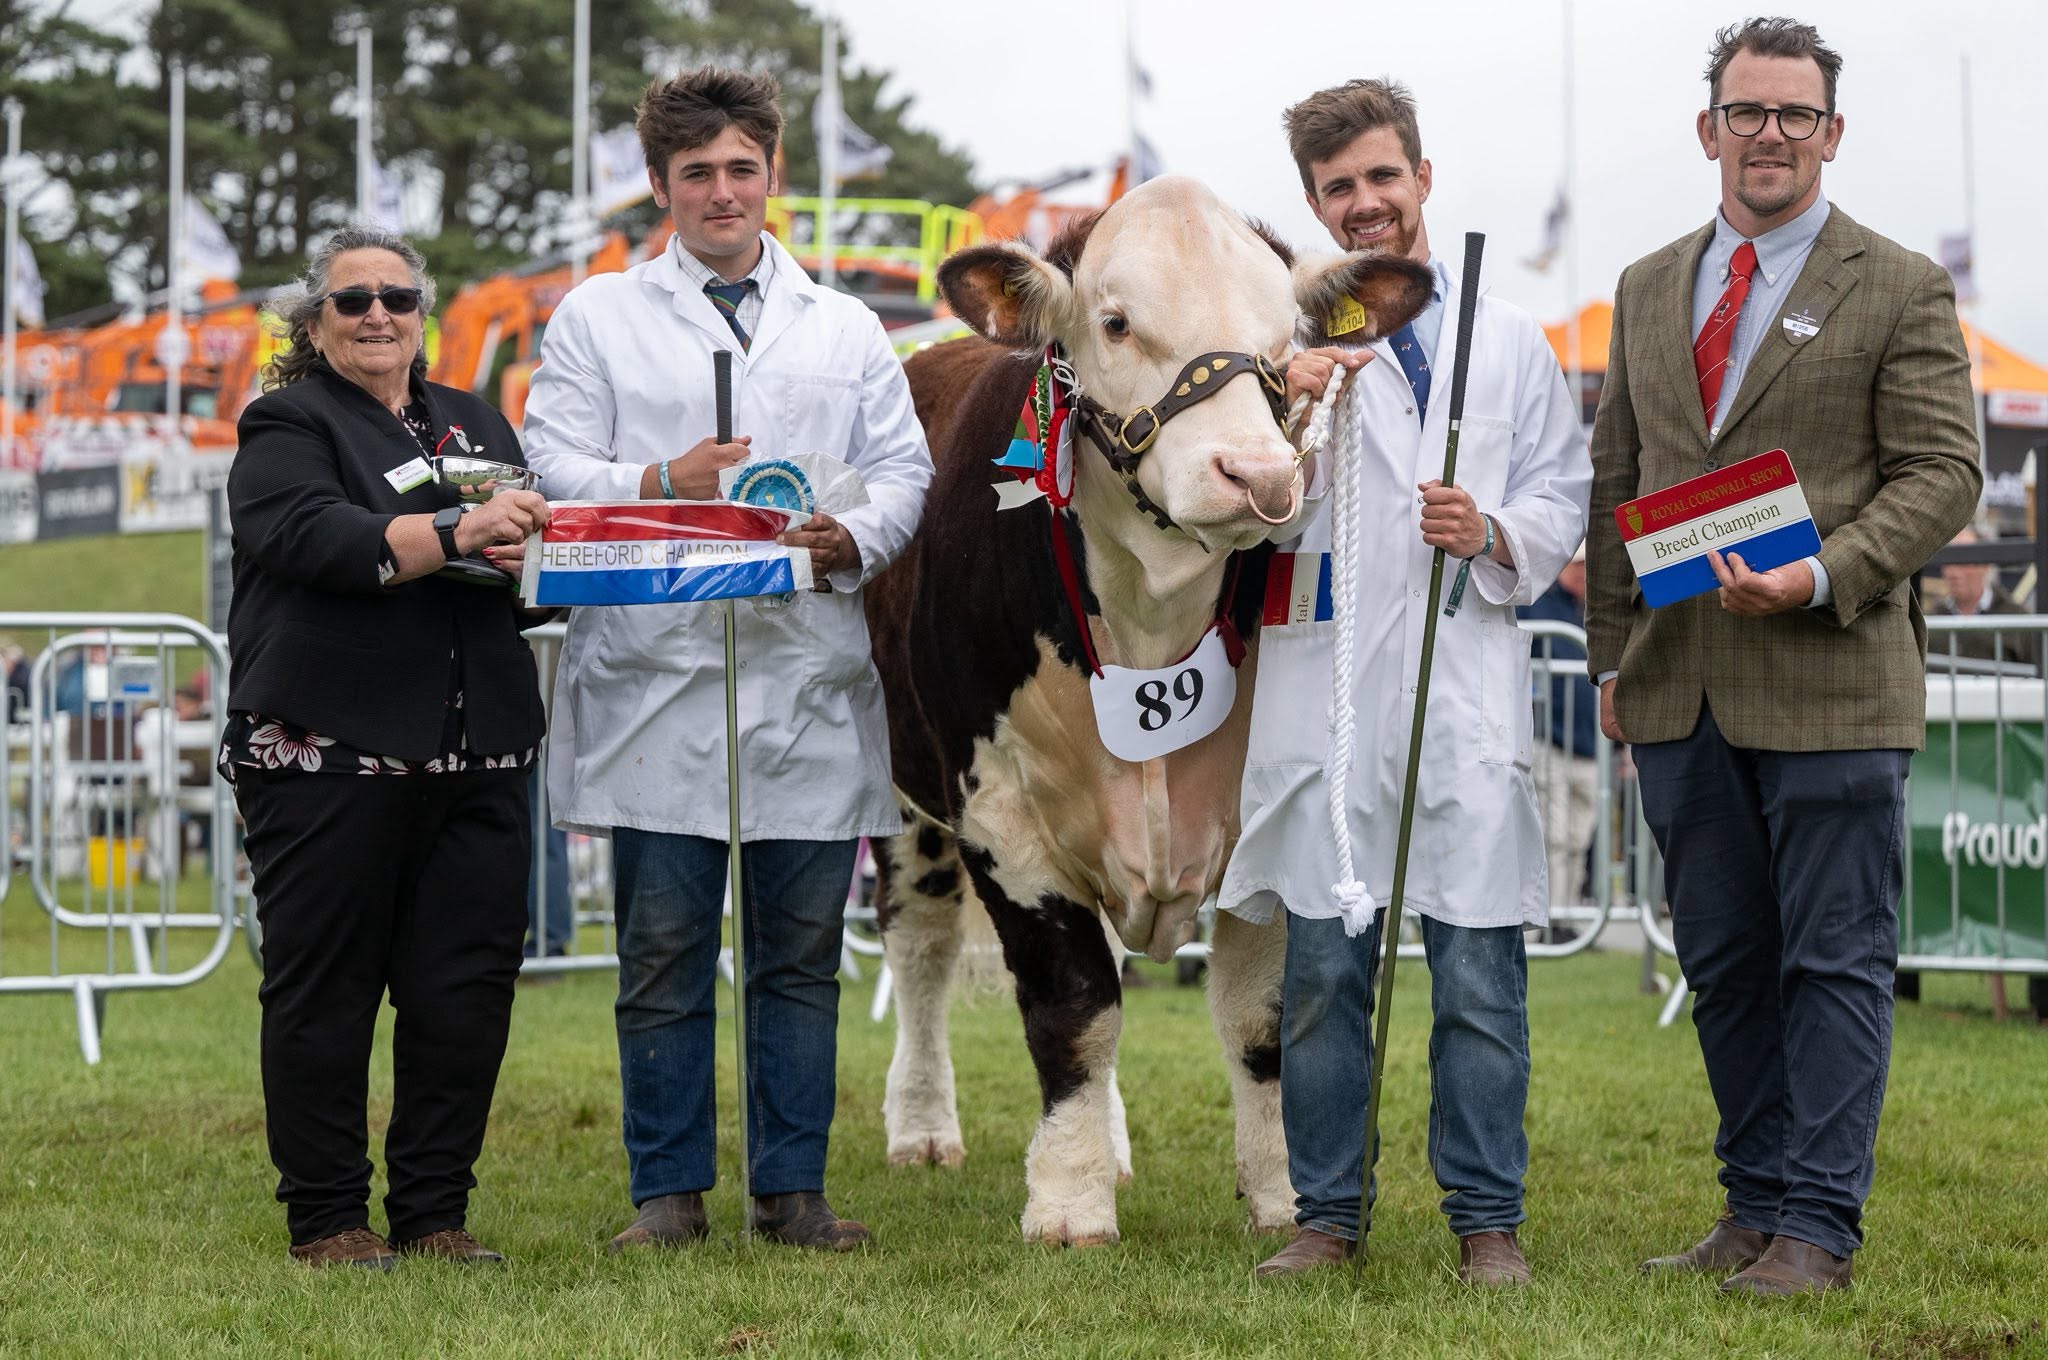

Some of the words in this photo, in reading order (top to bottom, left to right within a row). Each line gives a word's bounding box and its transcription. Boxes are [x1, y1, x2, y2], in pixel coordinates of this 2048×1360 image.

[1649, 498, 1689, 521] ROYAL
[1688, 477, 1751, 508] CORNWALL
[1749, 464, 1783, 487] SHOW
[541, 544, 643, 567] HEREFORD
[1651, 529, 1700, 560] Breed
[1701, 504, 1781, 542] Champion
[1134, 667, 1204, 732] 89
[1942, 811, 2047, 869] Proud
